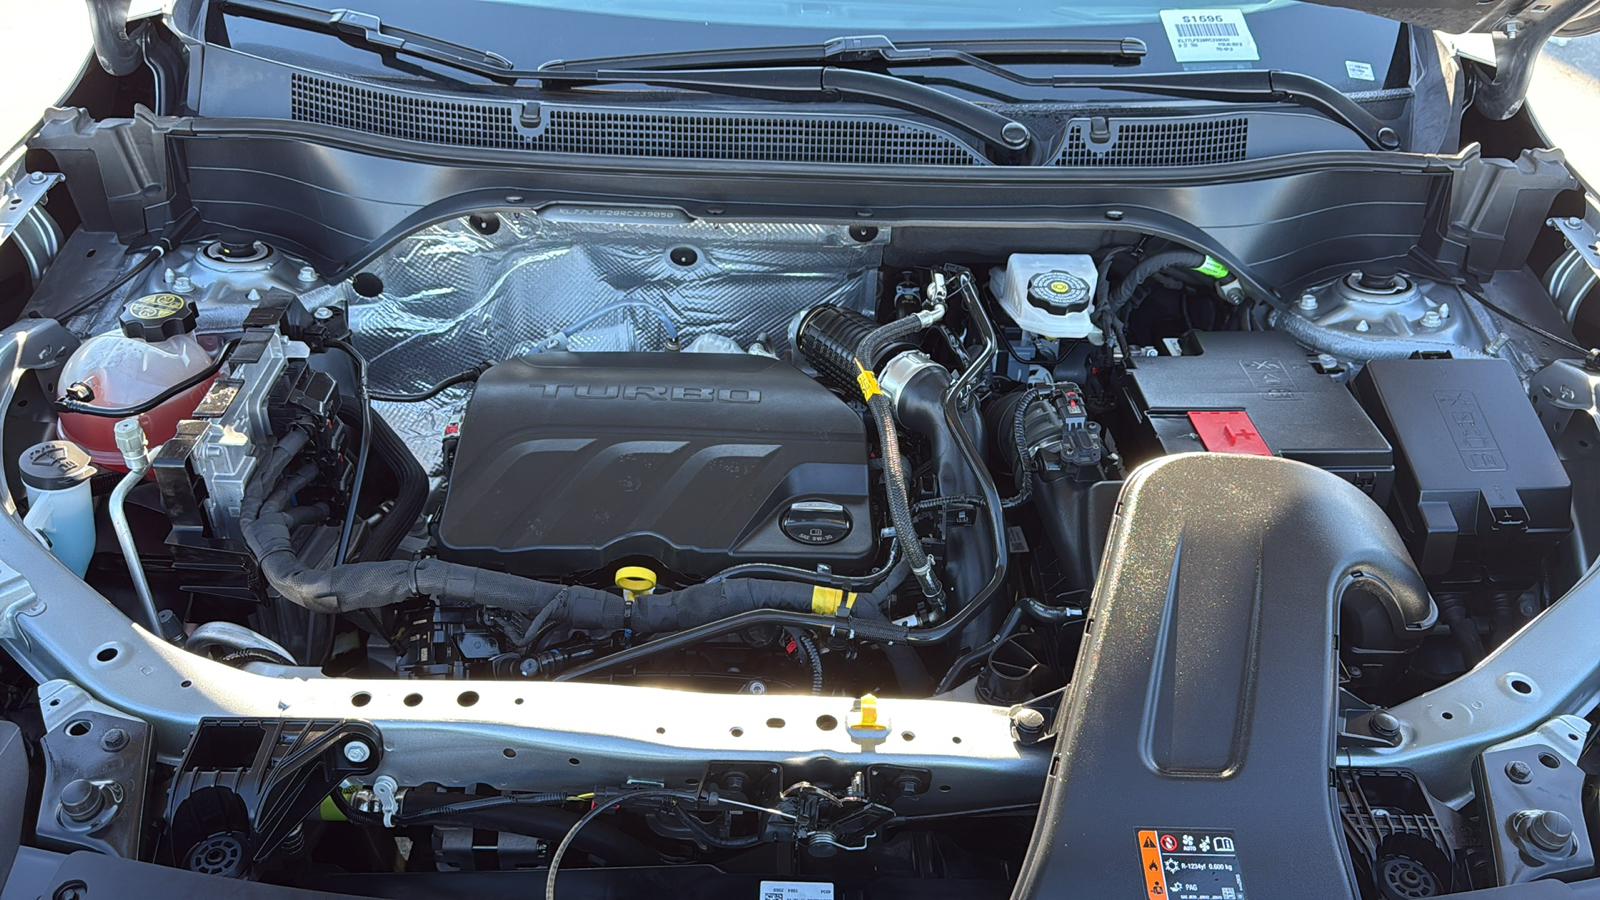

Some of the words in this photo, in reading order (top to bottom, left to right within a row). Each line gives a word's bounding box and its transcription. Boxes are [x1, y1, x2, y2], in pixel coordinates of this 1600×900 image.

[529, 383, 762, 404] TURBO
[1225, 864, 1233, 872] kg
[1185, 883, 1198, 891] PAG
